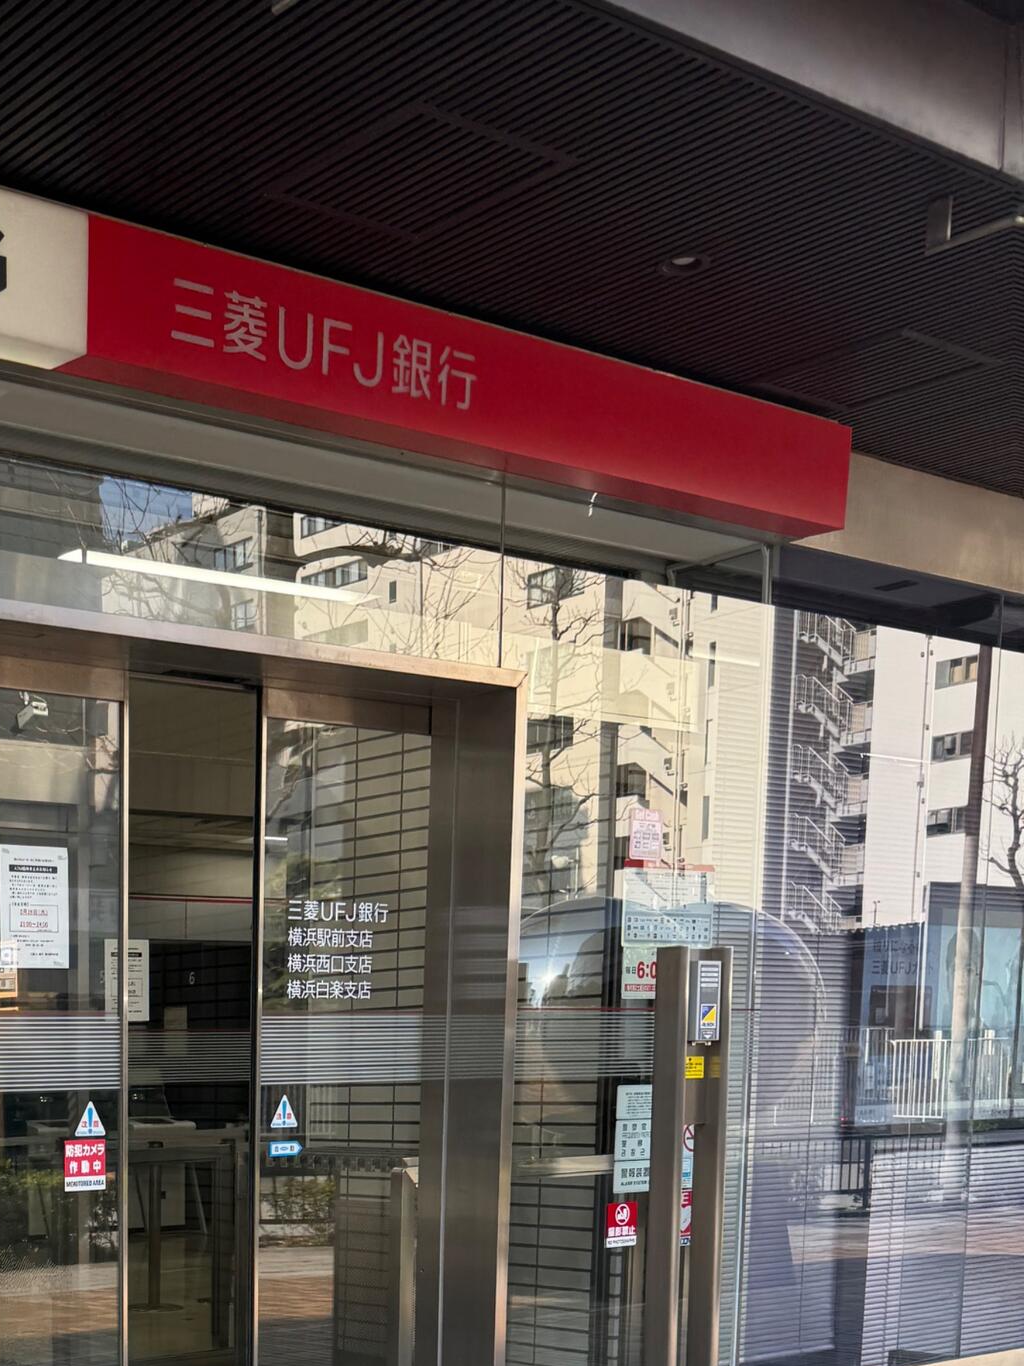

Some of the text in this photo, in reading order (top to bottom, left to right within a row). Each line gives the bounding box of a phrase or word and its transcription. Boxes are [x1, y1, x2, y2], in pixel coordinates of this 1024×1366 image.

[171, 278, 477, 410] 三菱UFJ銀行
[287, 900, 389, 923] 三菱UFJ銀行
[287, 927, 373, 948] 横浜駅前支店
[287, 953, 373, 974] 横浜西口支店
[286, 979, 371, 1000] 横浜白楽支店
[65, 1143, 105, 1158] 防犯カメラ
[69, 1160, 102, 1174] 作動中
